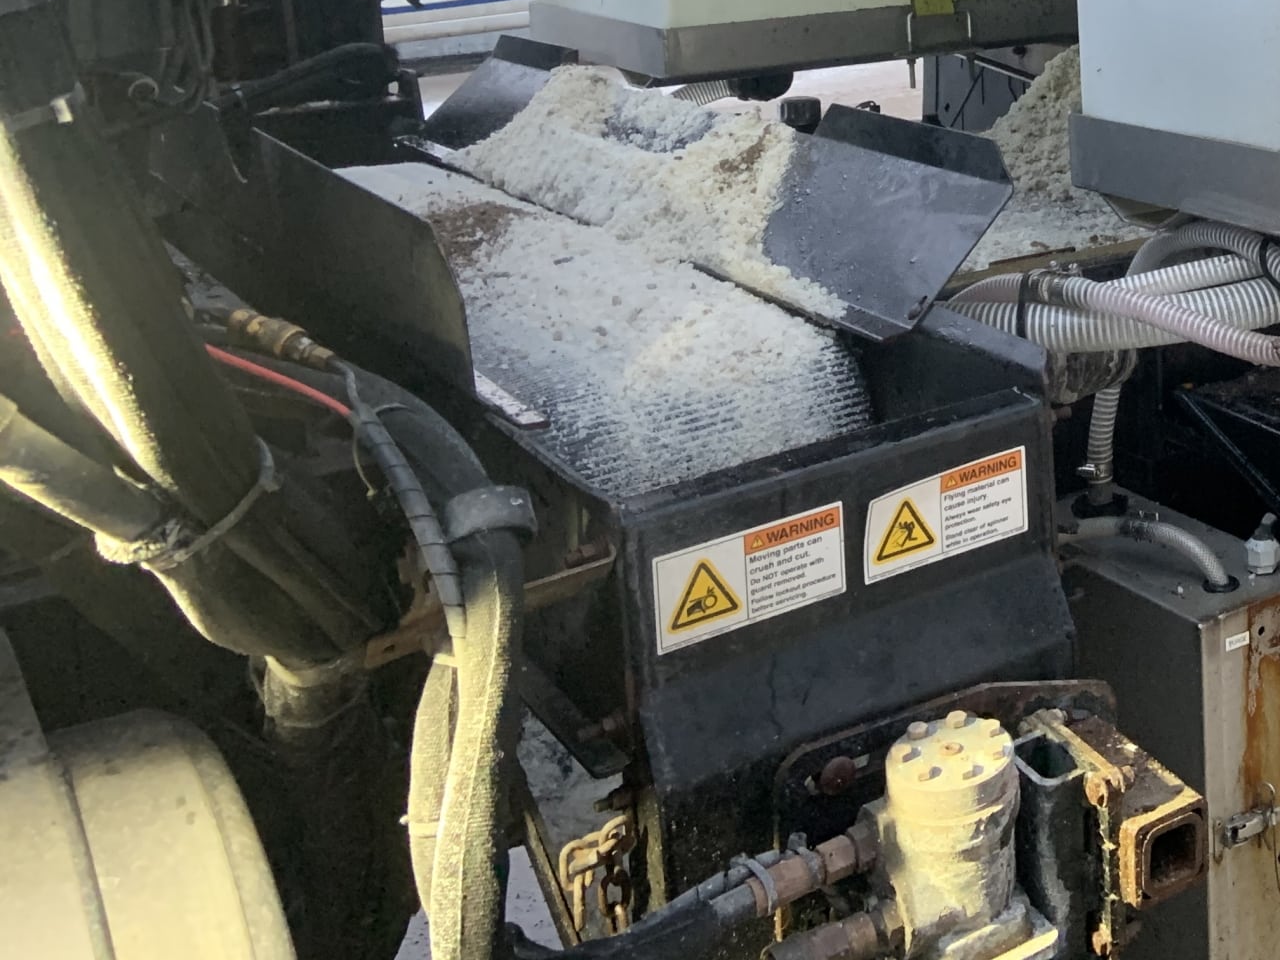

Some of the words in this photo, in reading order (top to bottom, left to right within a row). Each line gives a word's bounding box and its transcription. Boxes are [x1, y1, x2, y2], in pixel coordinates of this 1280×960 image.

[959, 454, 1016, 485] WARNING
[943, 489, 965, 503] Flying
[967, 479, 994, 494] material
[996, 475, 1009, 485] can
[943, 499, 965, 512] cause
[766, 511, 834, 544] WARNING
[749, 547, 780, 565] Moving
[783, 541, 804, 554] parts
[806, 536, 822, 546] can
[749, 560, 774, 575] crush
[776, 555, 792, 566] and
[795, 550, 810, 560] cut.
[750, 576, 760, 585] Do
[762, 571, 777, 581] NOT
[780, 561, 807, 577] operate
[809, 556, 823, 566] with
[750, 582, 771, 595] guard
[751, 592, 773, 604] Follow
[775, 584, 800, 596] lockout
[802, 572, 835, 588] procedure
